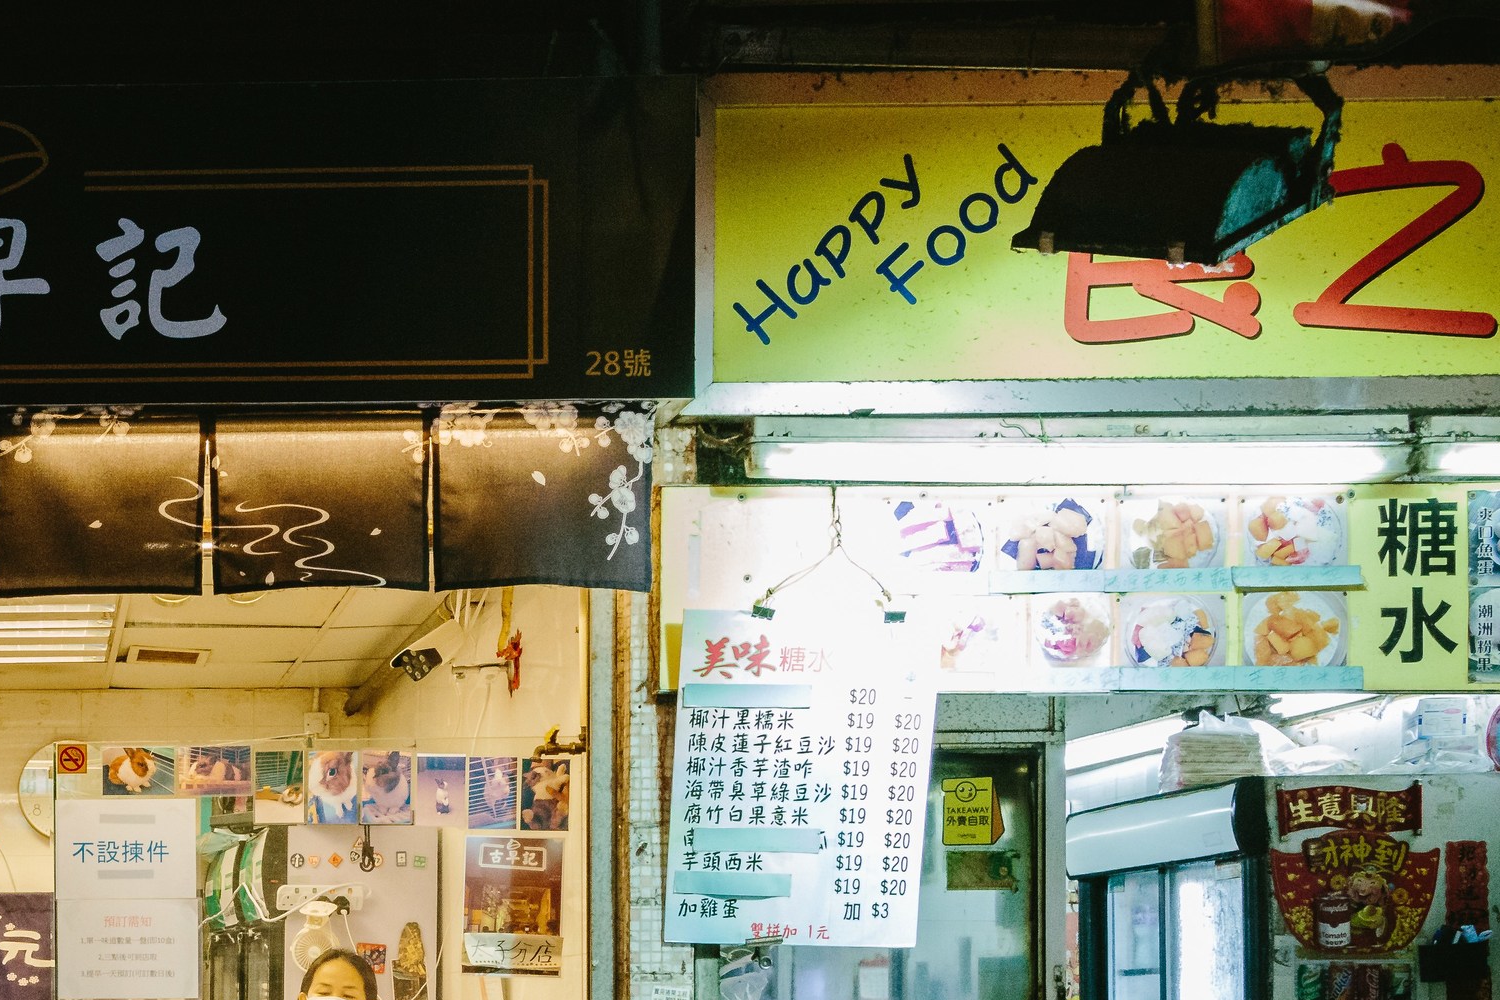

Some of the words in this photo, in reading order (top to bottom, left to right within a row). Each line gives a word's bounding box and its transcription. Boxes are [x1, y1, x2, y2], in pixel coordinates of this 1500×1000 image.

[877, 142, 1038, 304] Food
[732, 153, 922, 345] Happy
[585, 349, 651, 377] 28號
[1477, 508, 1494, 575] 爽口魚蛋
[1377, 498, 1458, 663] 糖水
[1477, 605, 1494, 672] 潮洲粉果
[849, 688, 877, 705] $20
[689, 709, 795, 730] 椰汁黑糯米
[847, 712, 874, 730] $19
[895, 713, 921, 731] $20
[688, 733, 835, 755] 陳皮蓮子紅豆沙
[845, 736, 872, 753] $19
[892, 737, 919, 755] $20
[843, 760, 870, 777] $19
[890, 761, 917, 778] $20
[685, 779, 832, 803] 海帶臭草綠豆沙
[841, 784, 868, 801] $19
[888, 786, 915, 802] $20
[684, 805, 809, 825] 腐竹白果意米
[839, 808, 866, 825] $19
[886, 809, 913, 826] $20
[946, 806, 990, 814] TAKEAWAY
[946, 815, 990, 826] 外賣自取
[72, 839, 170, 864] 不設揀件
[838, 832, 864, 849] $19
[884, 833, 911, 850] $20
[489, 849, 539, 866] 古早記
[681, 852, 764, 872] 芋頭西米
[836, 855, 862, 872] $19
[882, 856, 909, 873] $20
[834, 879, 861, 896] $19
[880, 880, 907, 897] $20
[678, 899, 740, 919] 加雞蛋
[843, 902, 861, 921] 加
[872, 903, 889, 919] $3
[808, 924, 830, 940] 1元
